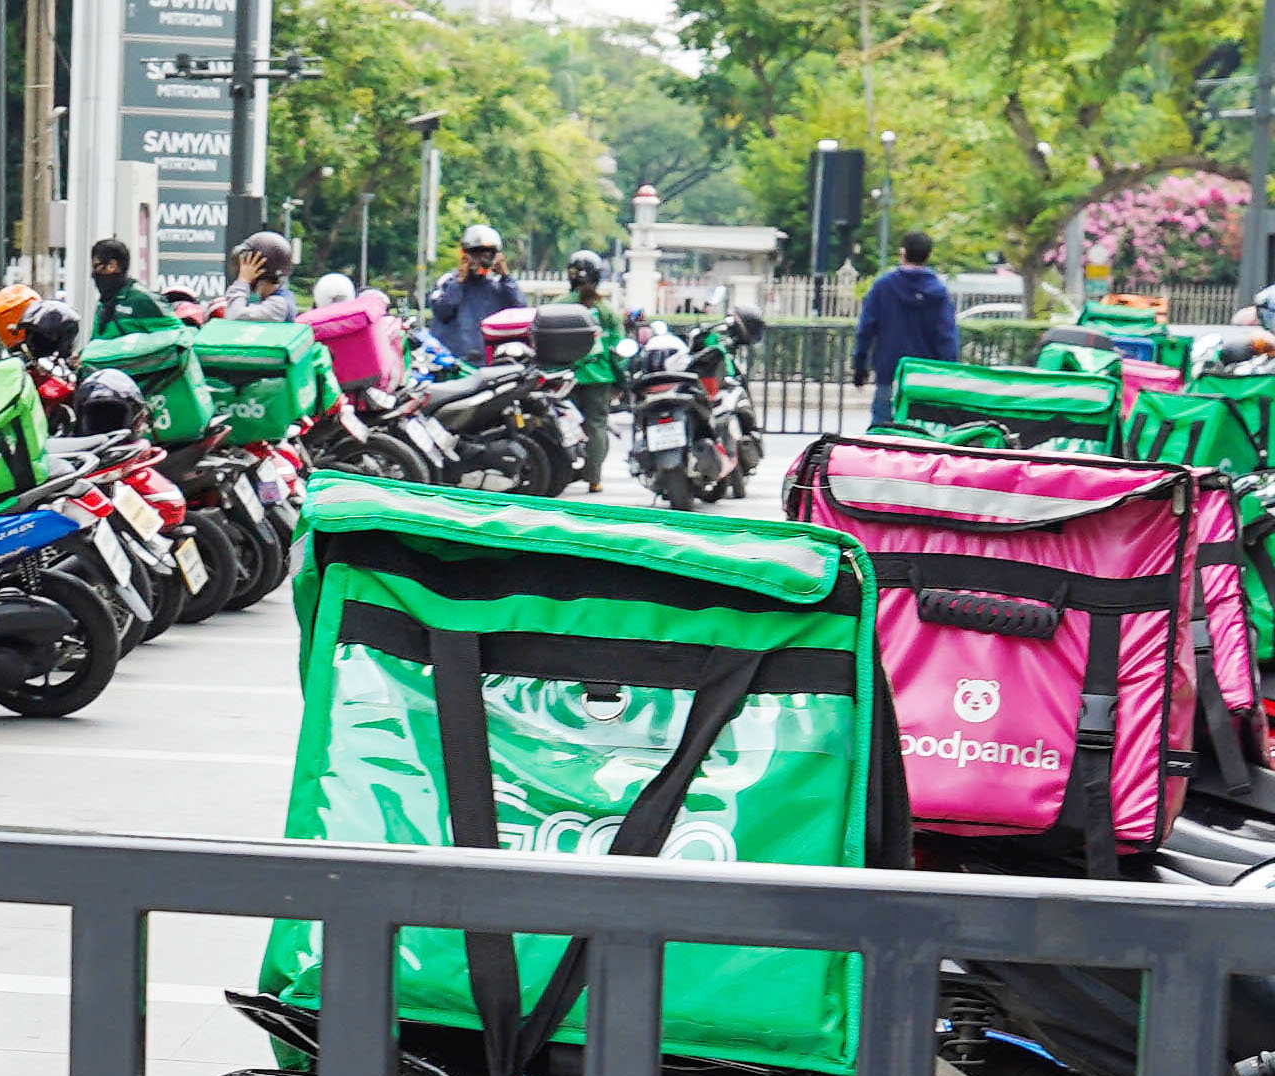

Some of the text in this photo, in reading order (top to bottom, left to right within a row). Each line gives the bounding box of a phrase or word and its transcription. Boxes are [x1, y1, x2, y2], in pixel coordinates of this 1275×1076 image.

[143, 130, 231, 156] SAMYAN
[156, 202, 228, 226] AMYAN
[900, 731, 1060, 770] oodpanda
